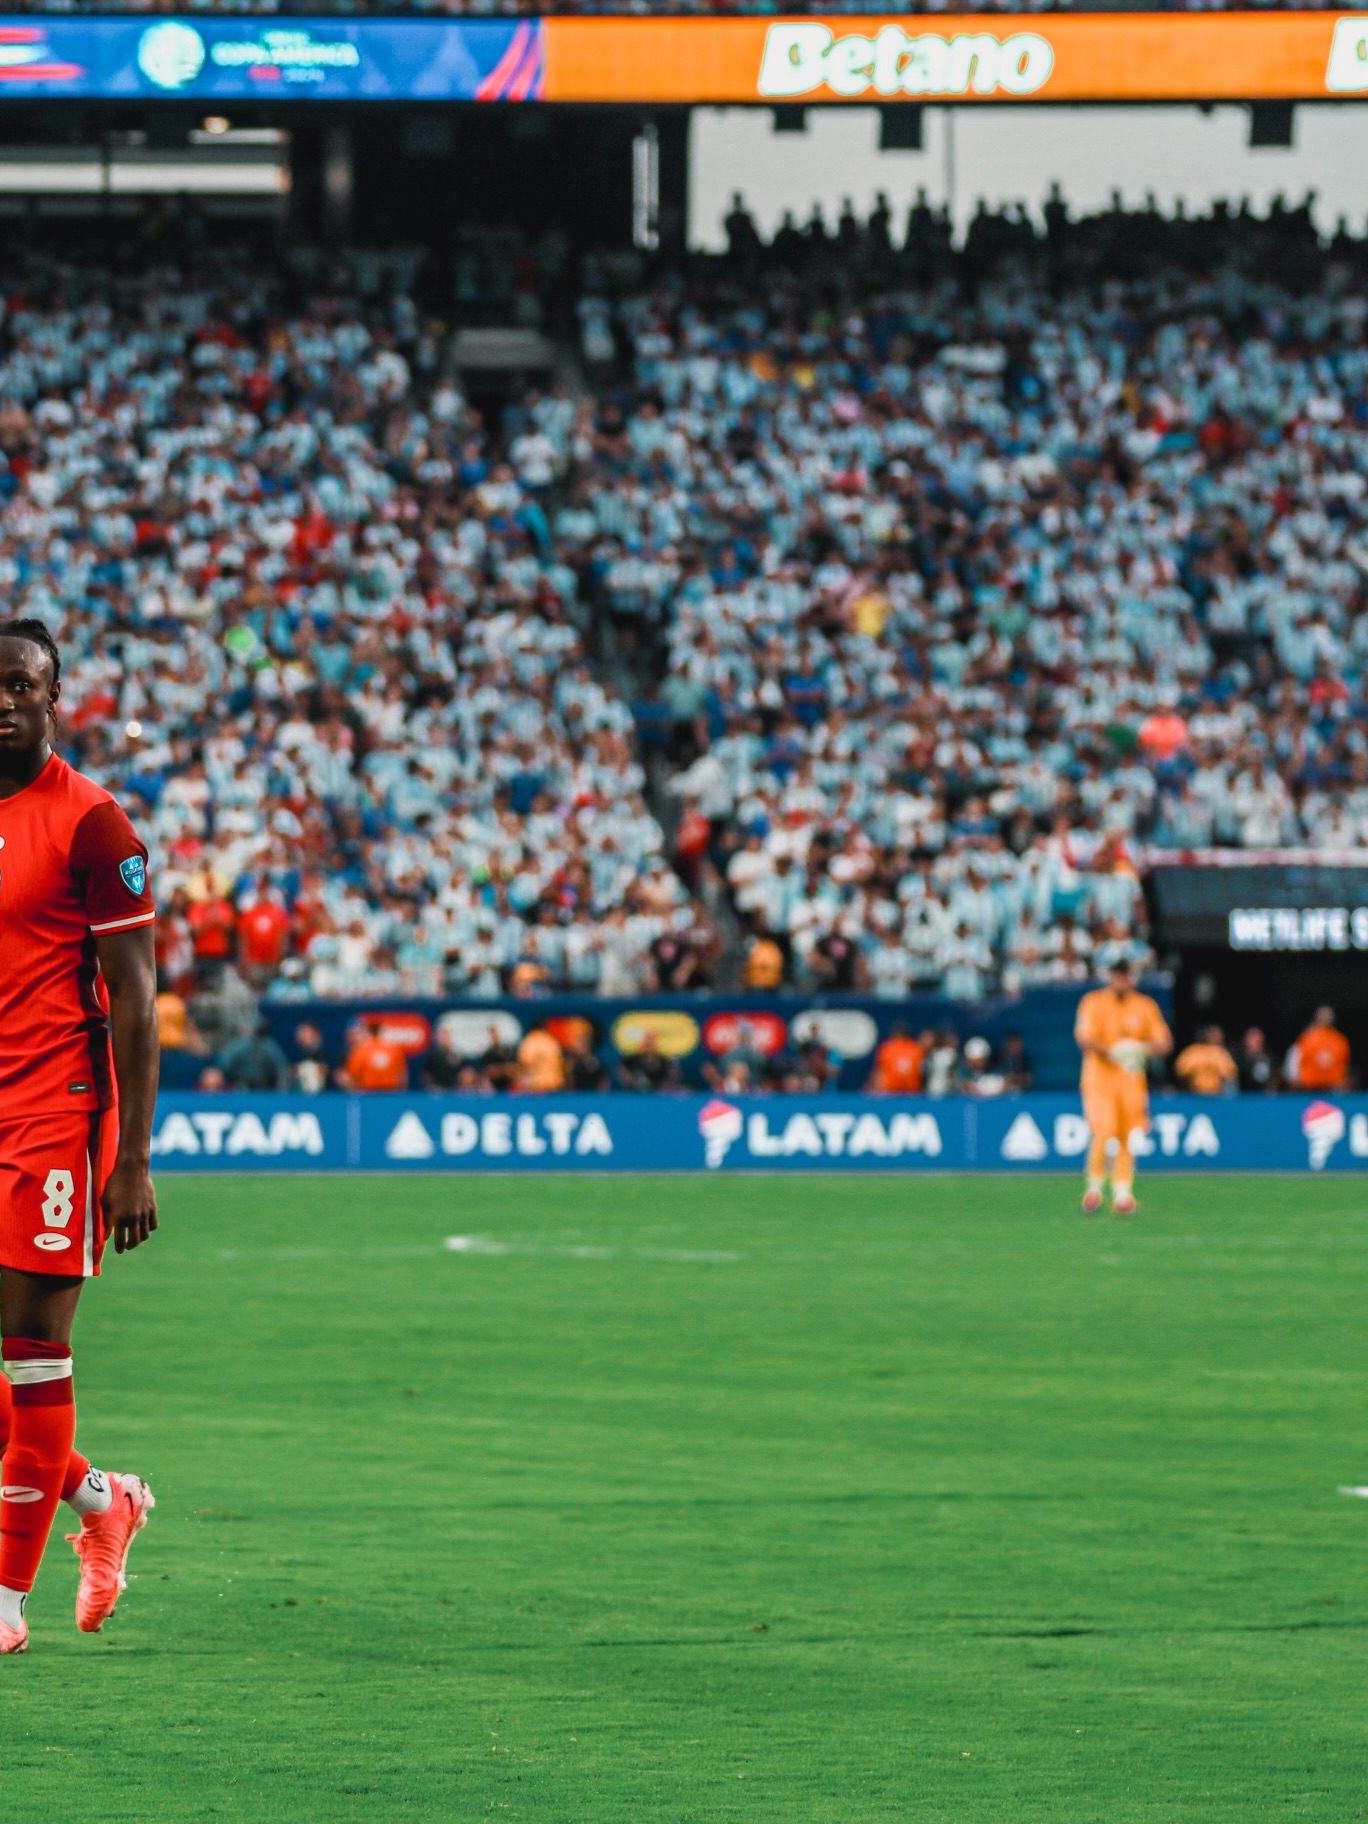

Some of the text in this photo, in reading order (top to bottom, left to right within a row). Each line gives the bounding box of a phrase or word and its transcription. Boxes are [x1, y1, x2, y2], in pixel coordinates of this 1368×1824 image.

[758, 22, 1055, 97] Betano
[441, 1112, 613, 1156] DELTA
[747, 1112, 942, 1156] LATAM
[1054, 1113, 1220, 1157] DLTA
[41, 1168, 75, 1228] 8
